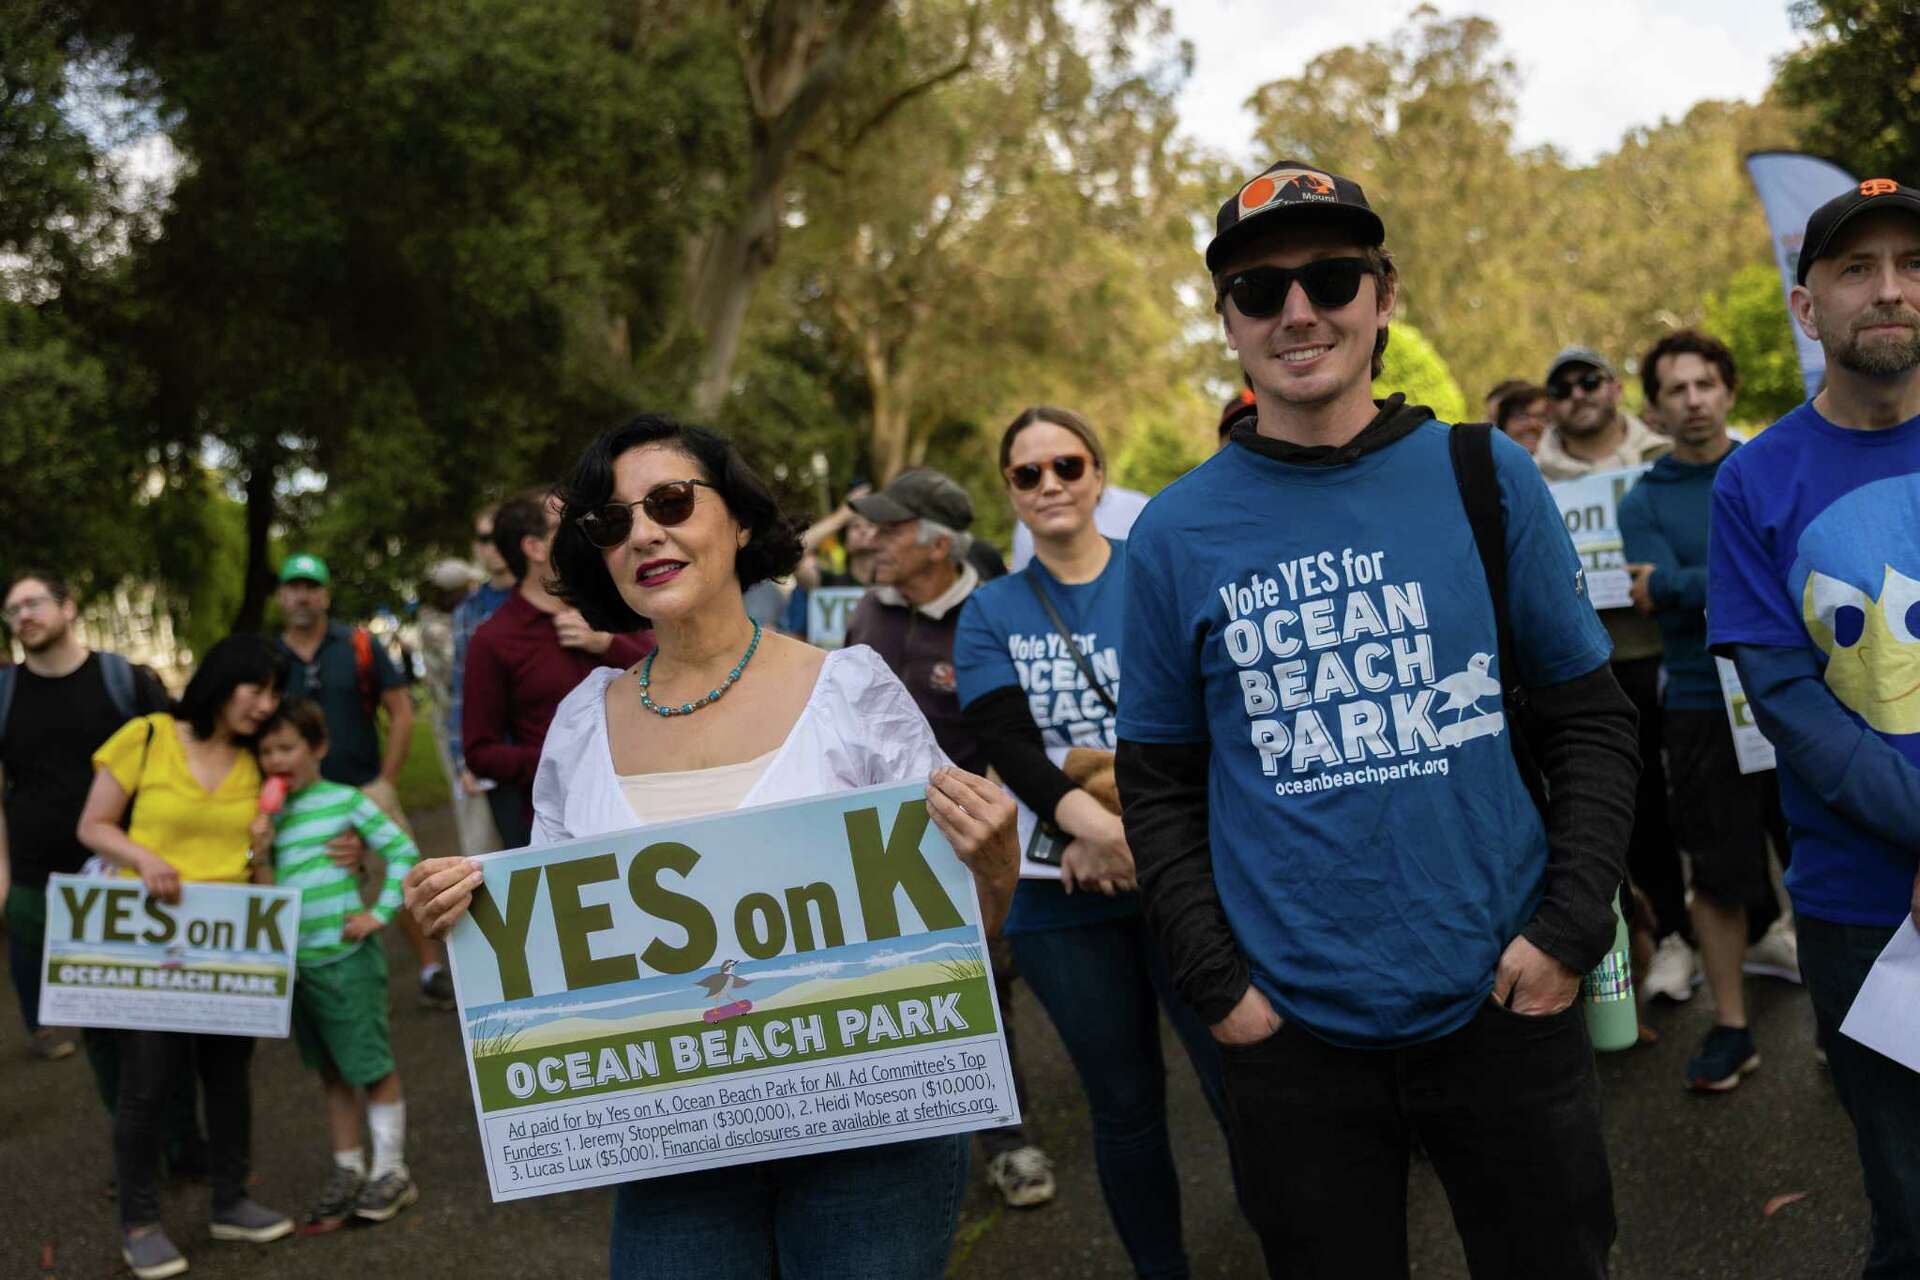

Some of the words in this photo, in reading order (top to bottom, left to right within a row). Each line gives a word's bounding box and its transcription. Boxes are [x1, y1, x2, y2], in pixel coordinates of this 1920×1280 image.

[1302, 192, 1335, 203] Mount
[1565, 505, 1604, 533] on
[1218, 574, 1280, 620] Vote
[1278, 551, 1340, 601] YES
[1341, 548, 1385, 587] for
[1223, 581, 1429, 667] OCEAN
[1238, 634, 1436, 717] BEACH
[1250, 689, 1445, 776] PARK
[1275, 758, 1449, 797] oceanbeachpark.org
[60, 887, 176, 944] YES
[187, 920, 234, 947] on
[245, 896, 288, 952] K
[466, 842, 718, 1002] YES
[734, 880, 846, 960] on
[843, 799, 967, 942] K
[506, 1040, 660, 1099] OCEAN
[670, 1014, 827, 1073] BEACH
[837, 992, 969, 1048] PARK
[503, 1141, 562, 1162] Funders:
[566, 1137, 576, 1151] 1.
[578, 1130, 625, 1151] Jeremy
[628, 1118, 708, 1143] Stoppelman
[800, 1100, 812, 1116] 2.
[816, 1094, 850, 1114] Heidi
[854, 1086, 917, 1108] Moseson
[509, 1120, 526, 1138] Ad
[531, 1116, 560, 1140] paid
[563, 1113, 582, 1129] for
[586, 1110, 602, 1128] by
[606, 1106, 630, 1122] Yes
[634, 1103, 651, 1118] on
[672, 1095, 715, 1112] Ocean
[718, 1084, 761, 1104] Beach
[765, 1078, 798, 1097] Park
[800, 1075, 820, 1093] for
[825, 1071, 845, 1089] All.
[849, 1069, 867, 1085] Ad
[959, 1051, 986, 1070] Top
[511, 1165, 523, 1181] 3.
[526, 1161, 565, 1179] Lucas
[567, 1153, 593, 1172] Lux
[662, 1132, 721, 1157] Financial
[725, 1125, 800, 1147] disclosures
[805, 1120, 826, 1136] are
[832, 1108, 891, 1132] available
[896, 1106, 908, 1123] at
[914, 1096, 998, 1120] sfethics.org.
